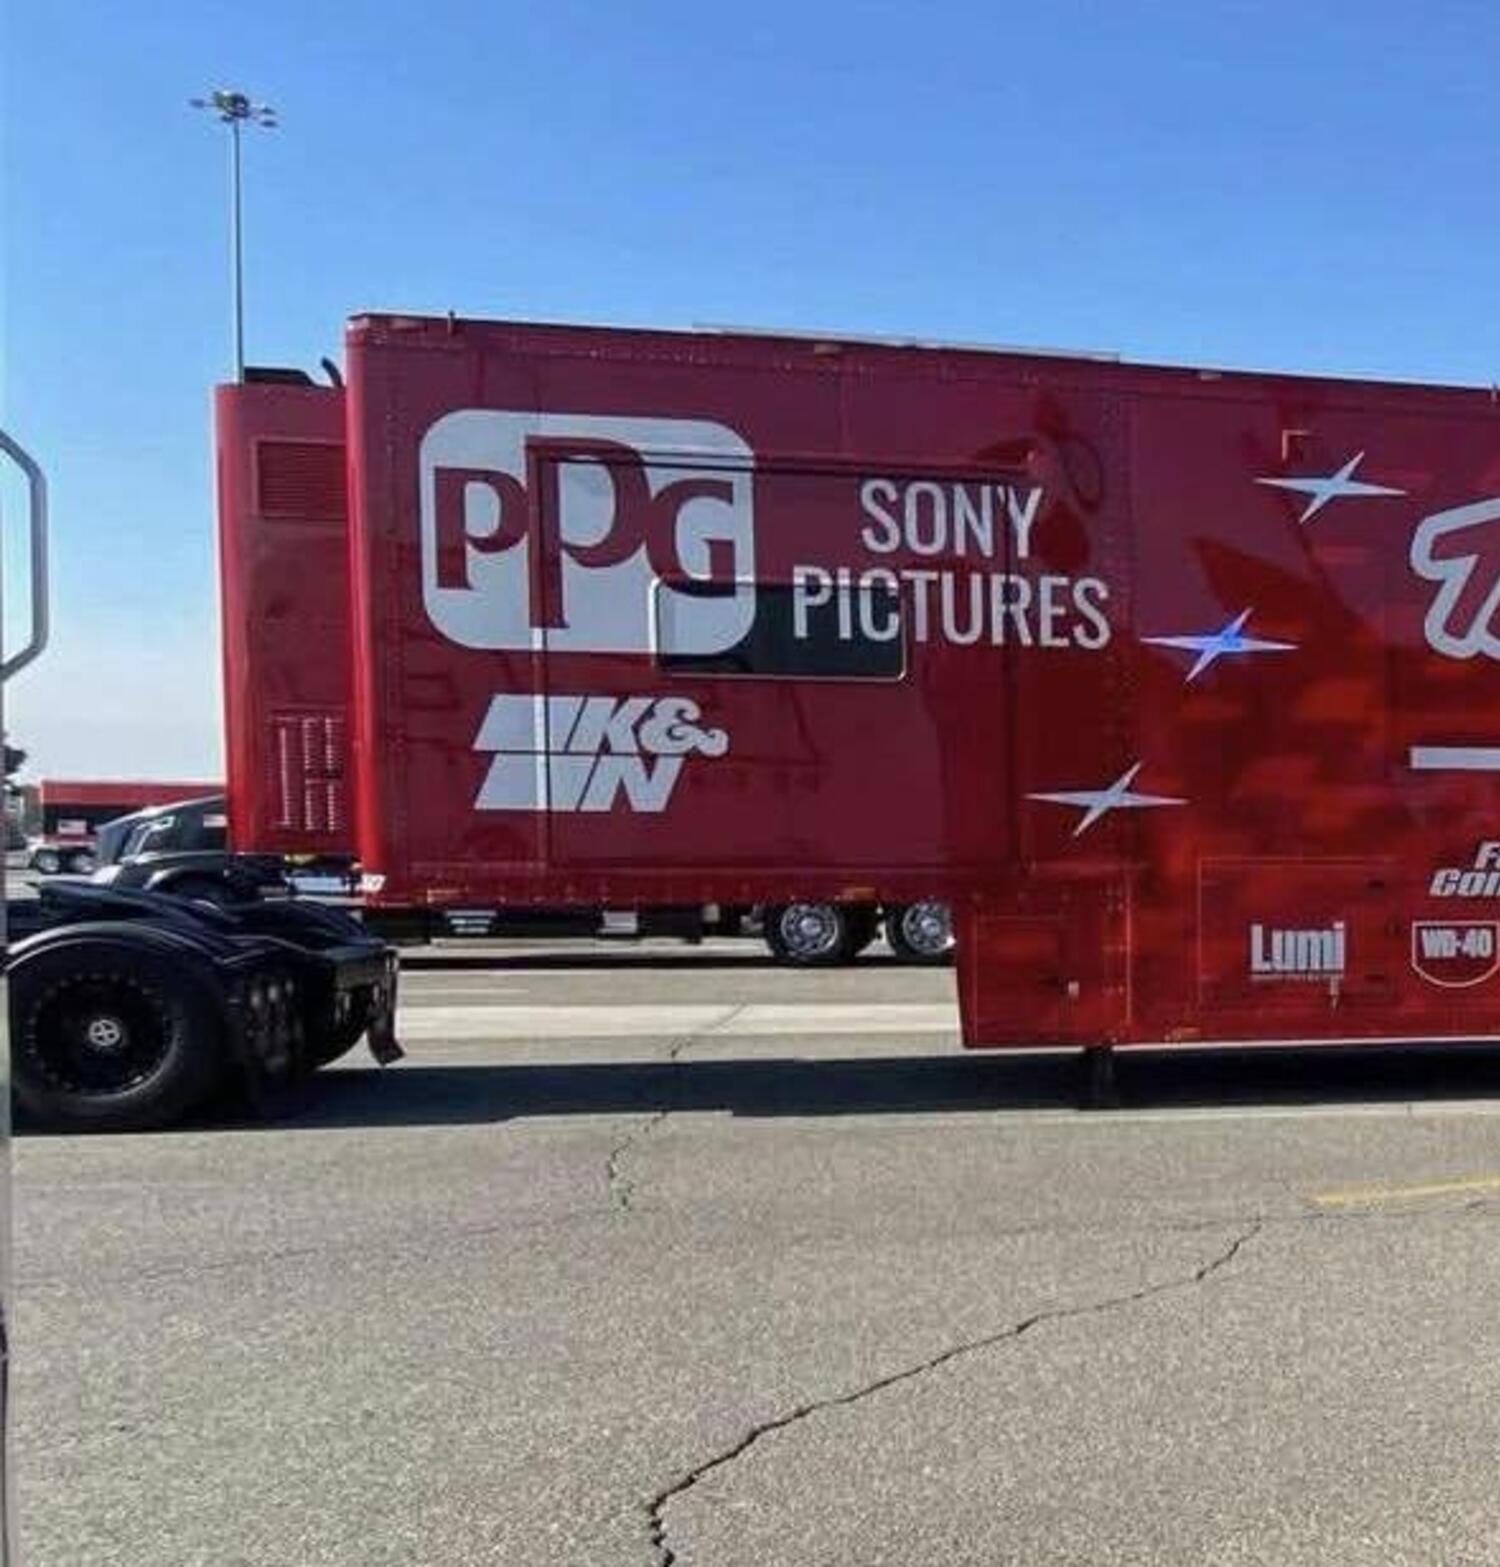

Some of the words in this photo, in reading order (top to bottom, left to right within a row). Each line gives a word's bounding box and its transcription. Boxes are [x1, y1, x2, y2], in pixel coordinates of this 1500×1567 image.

[434, 435, 739, 630] PPG
[860, 478, 1043, 558] SONY
[792, 565, 1111, 649] PICTURES
[1251, 922, 1345, 971] Lumi
[1421, 928, 1494, 959] WD-40
